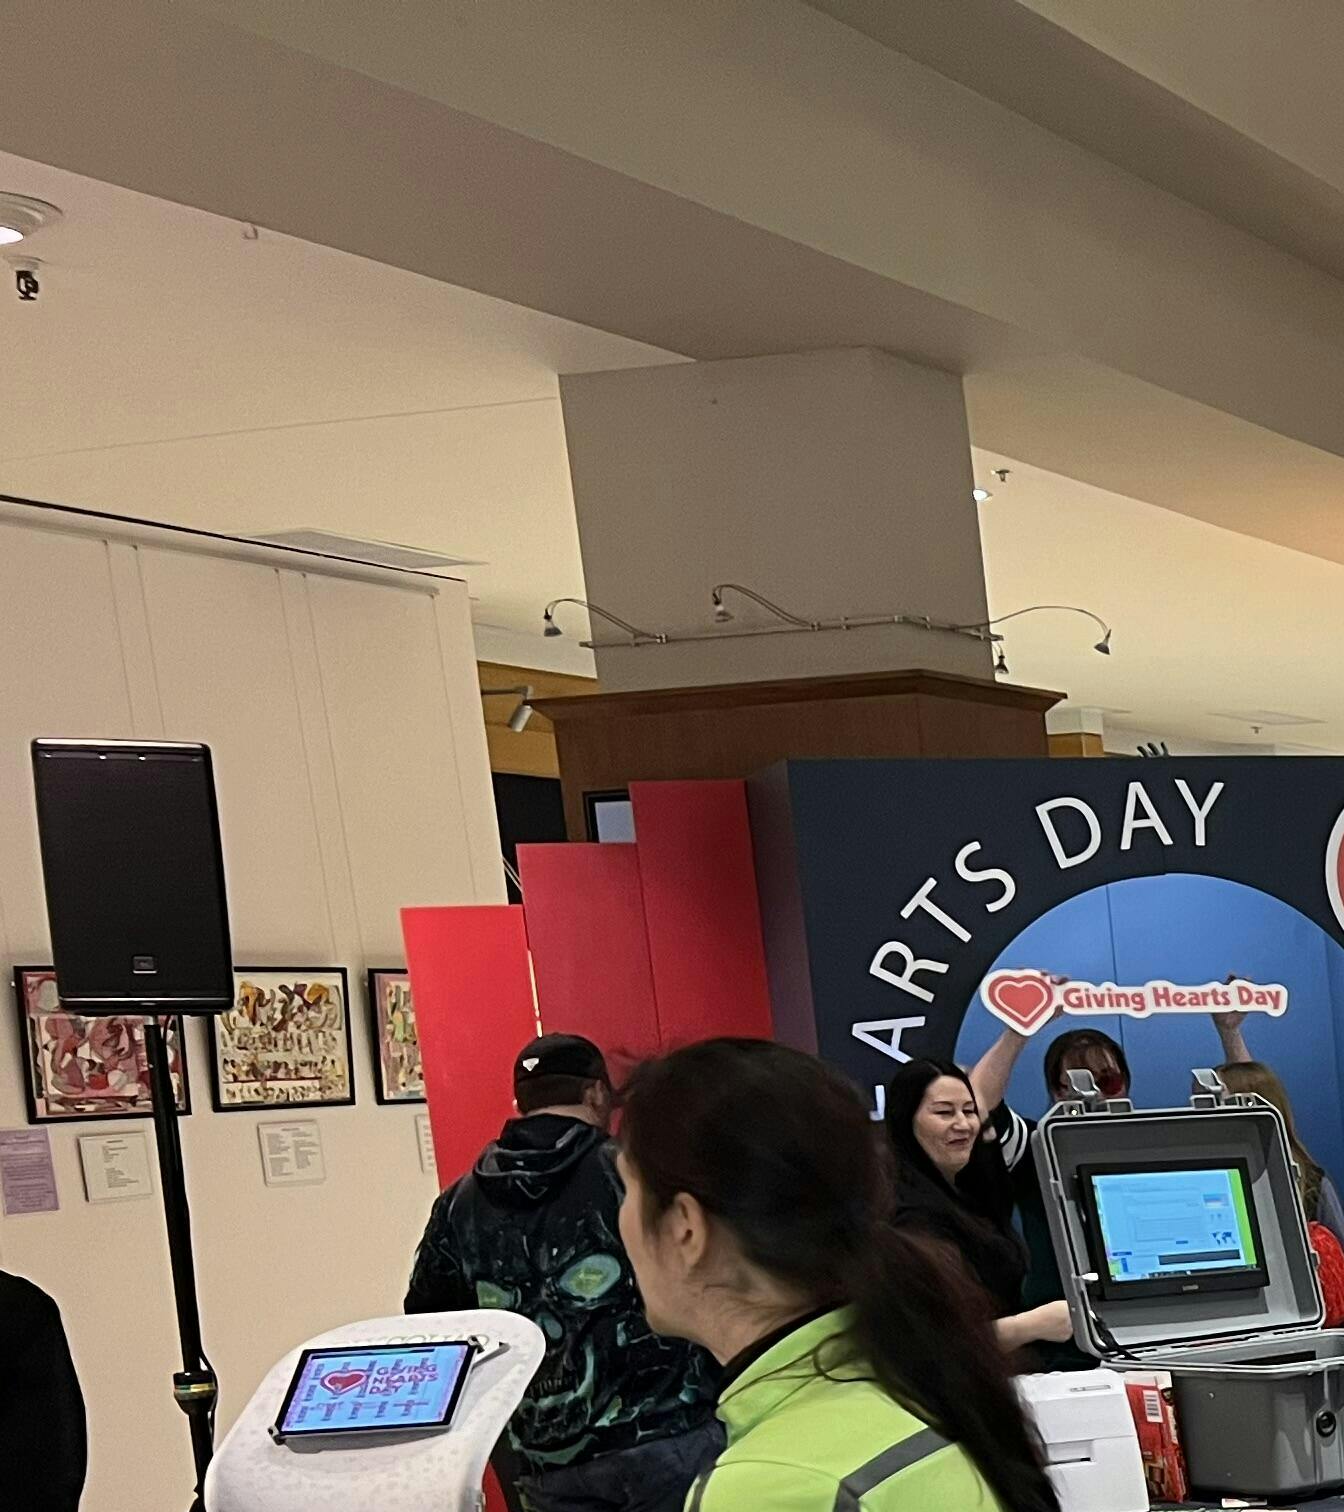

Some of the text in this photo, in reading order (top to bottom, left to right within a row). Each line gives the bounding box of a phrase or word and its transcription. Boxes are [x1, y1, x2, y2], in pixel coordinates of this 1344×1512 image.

[1035, 778, 1225, 870] DAY
[1063, 985, 1282, 1012] Giving Hearts Day
